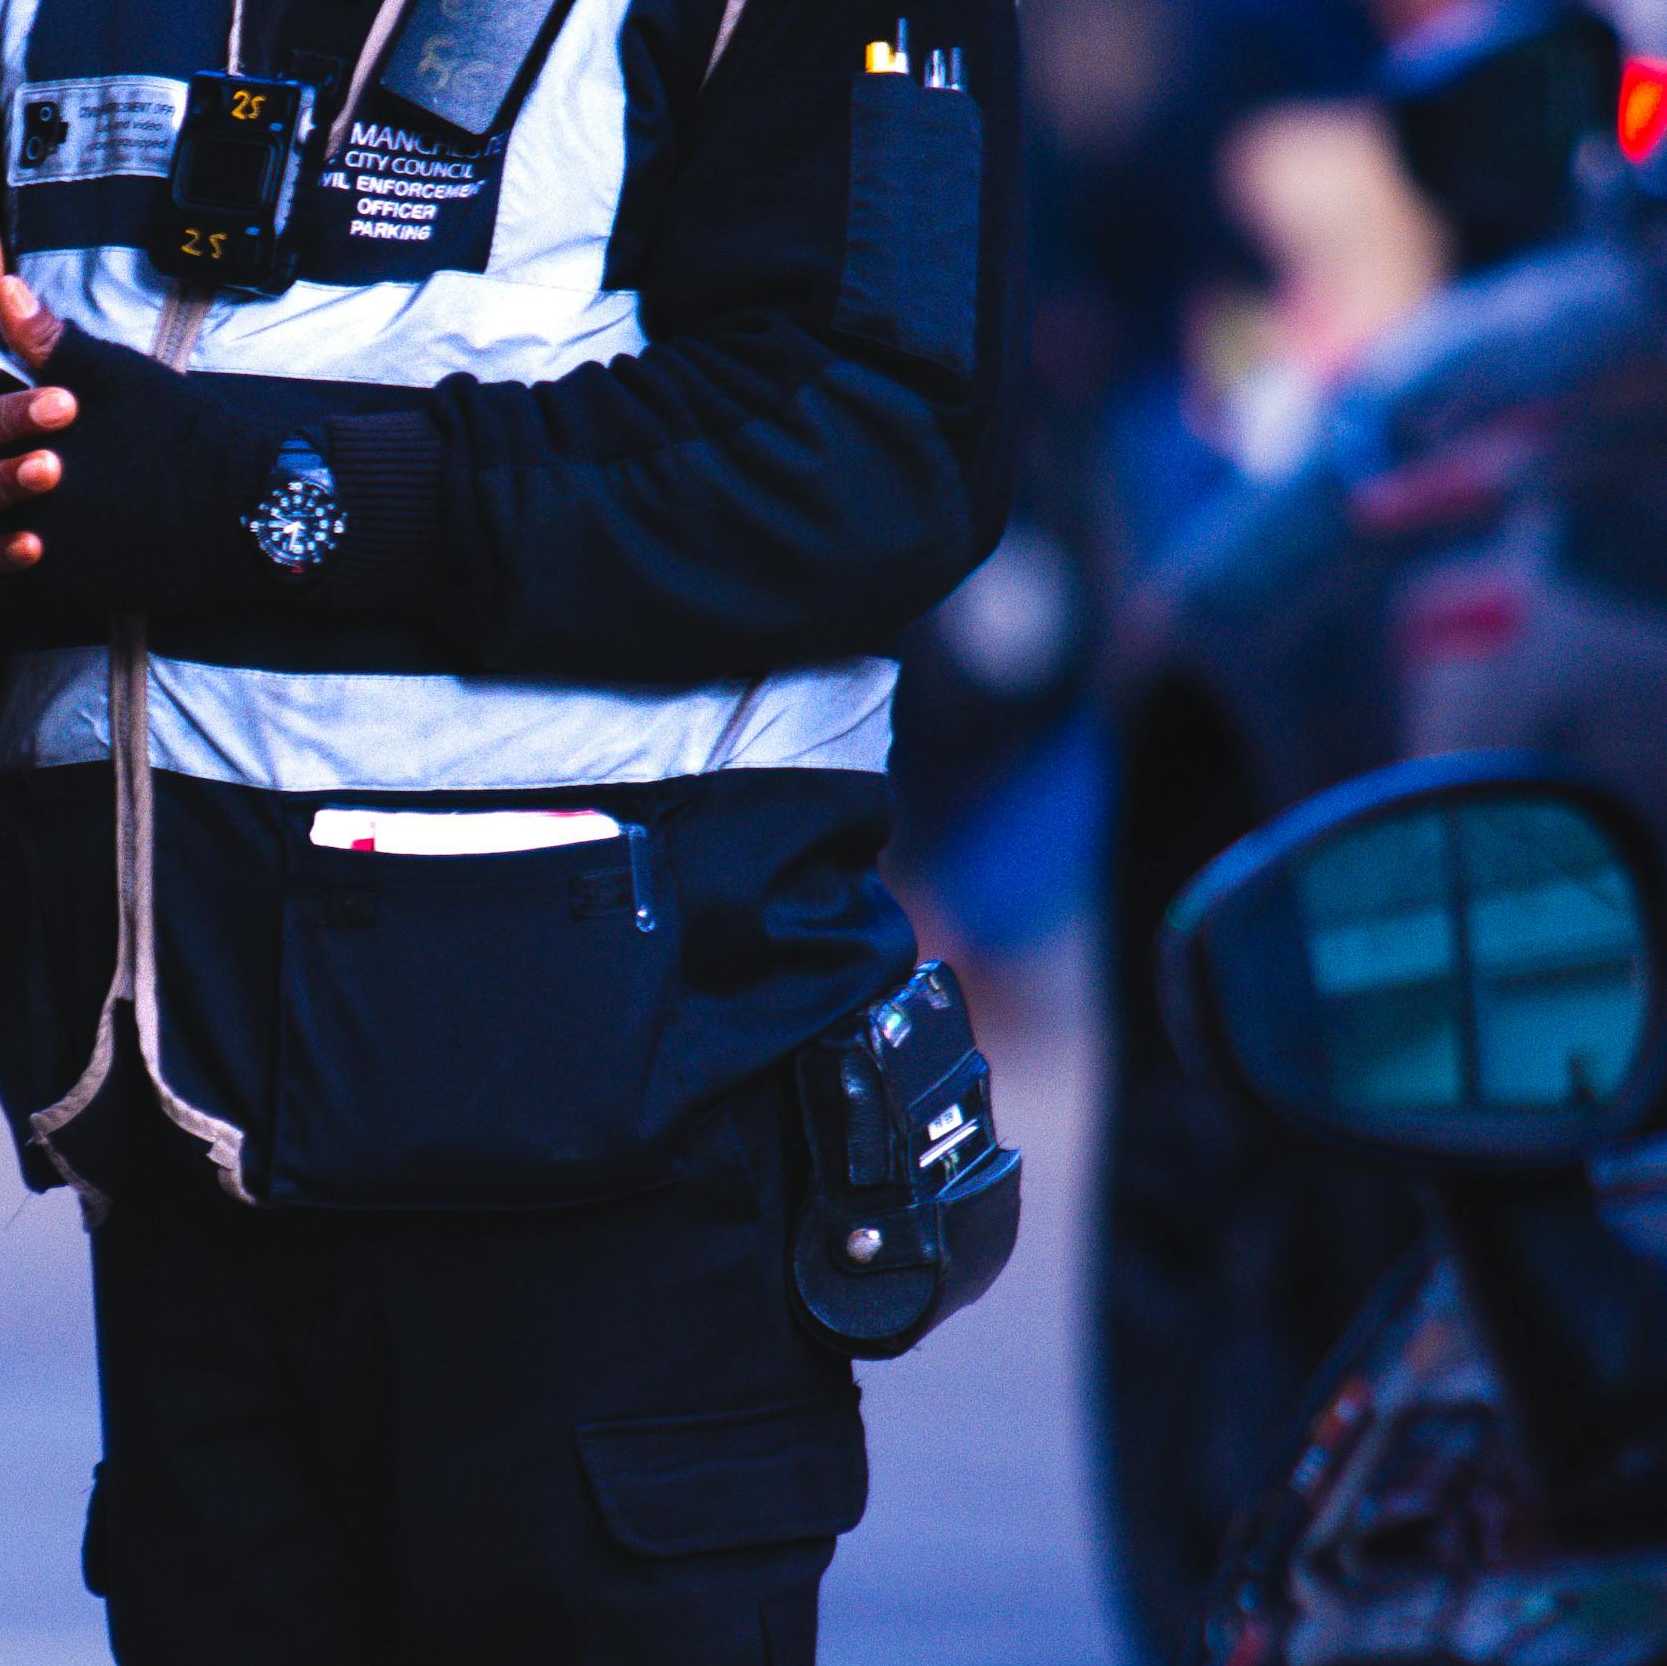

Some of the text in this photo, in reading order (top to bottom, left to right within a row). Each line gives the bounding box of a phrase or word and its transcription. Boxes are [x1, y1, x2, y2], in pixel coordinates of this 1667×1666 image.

[231, 90, 269, 120] 25
[344, 150, 475, 179] CITY COUNCIL
[356, 197, 438, 221] OFFICER
[181, 227, 228, 260] 25
[350, 220, 432, 241] PARKING
